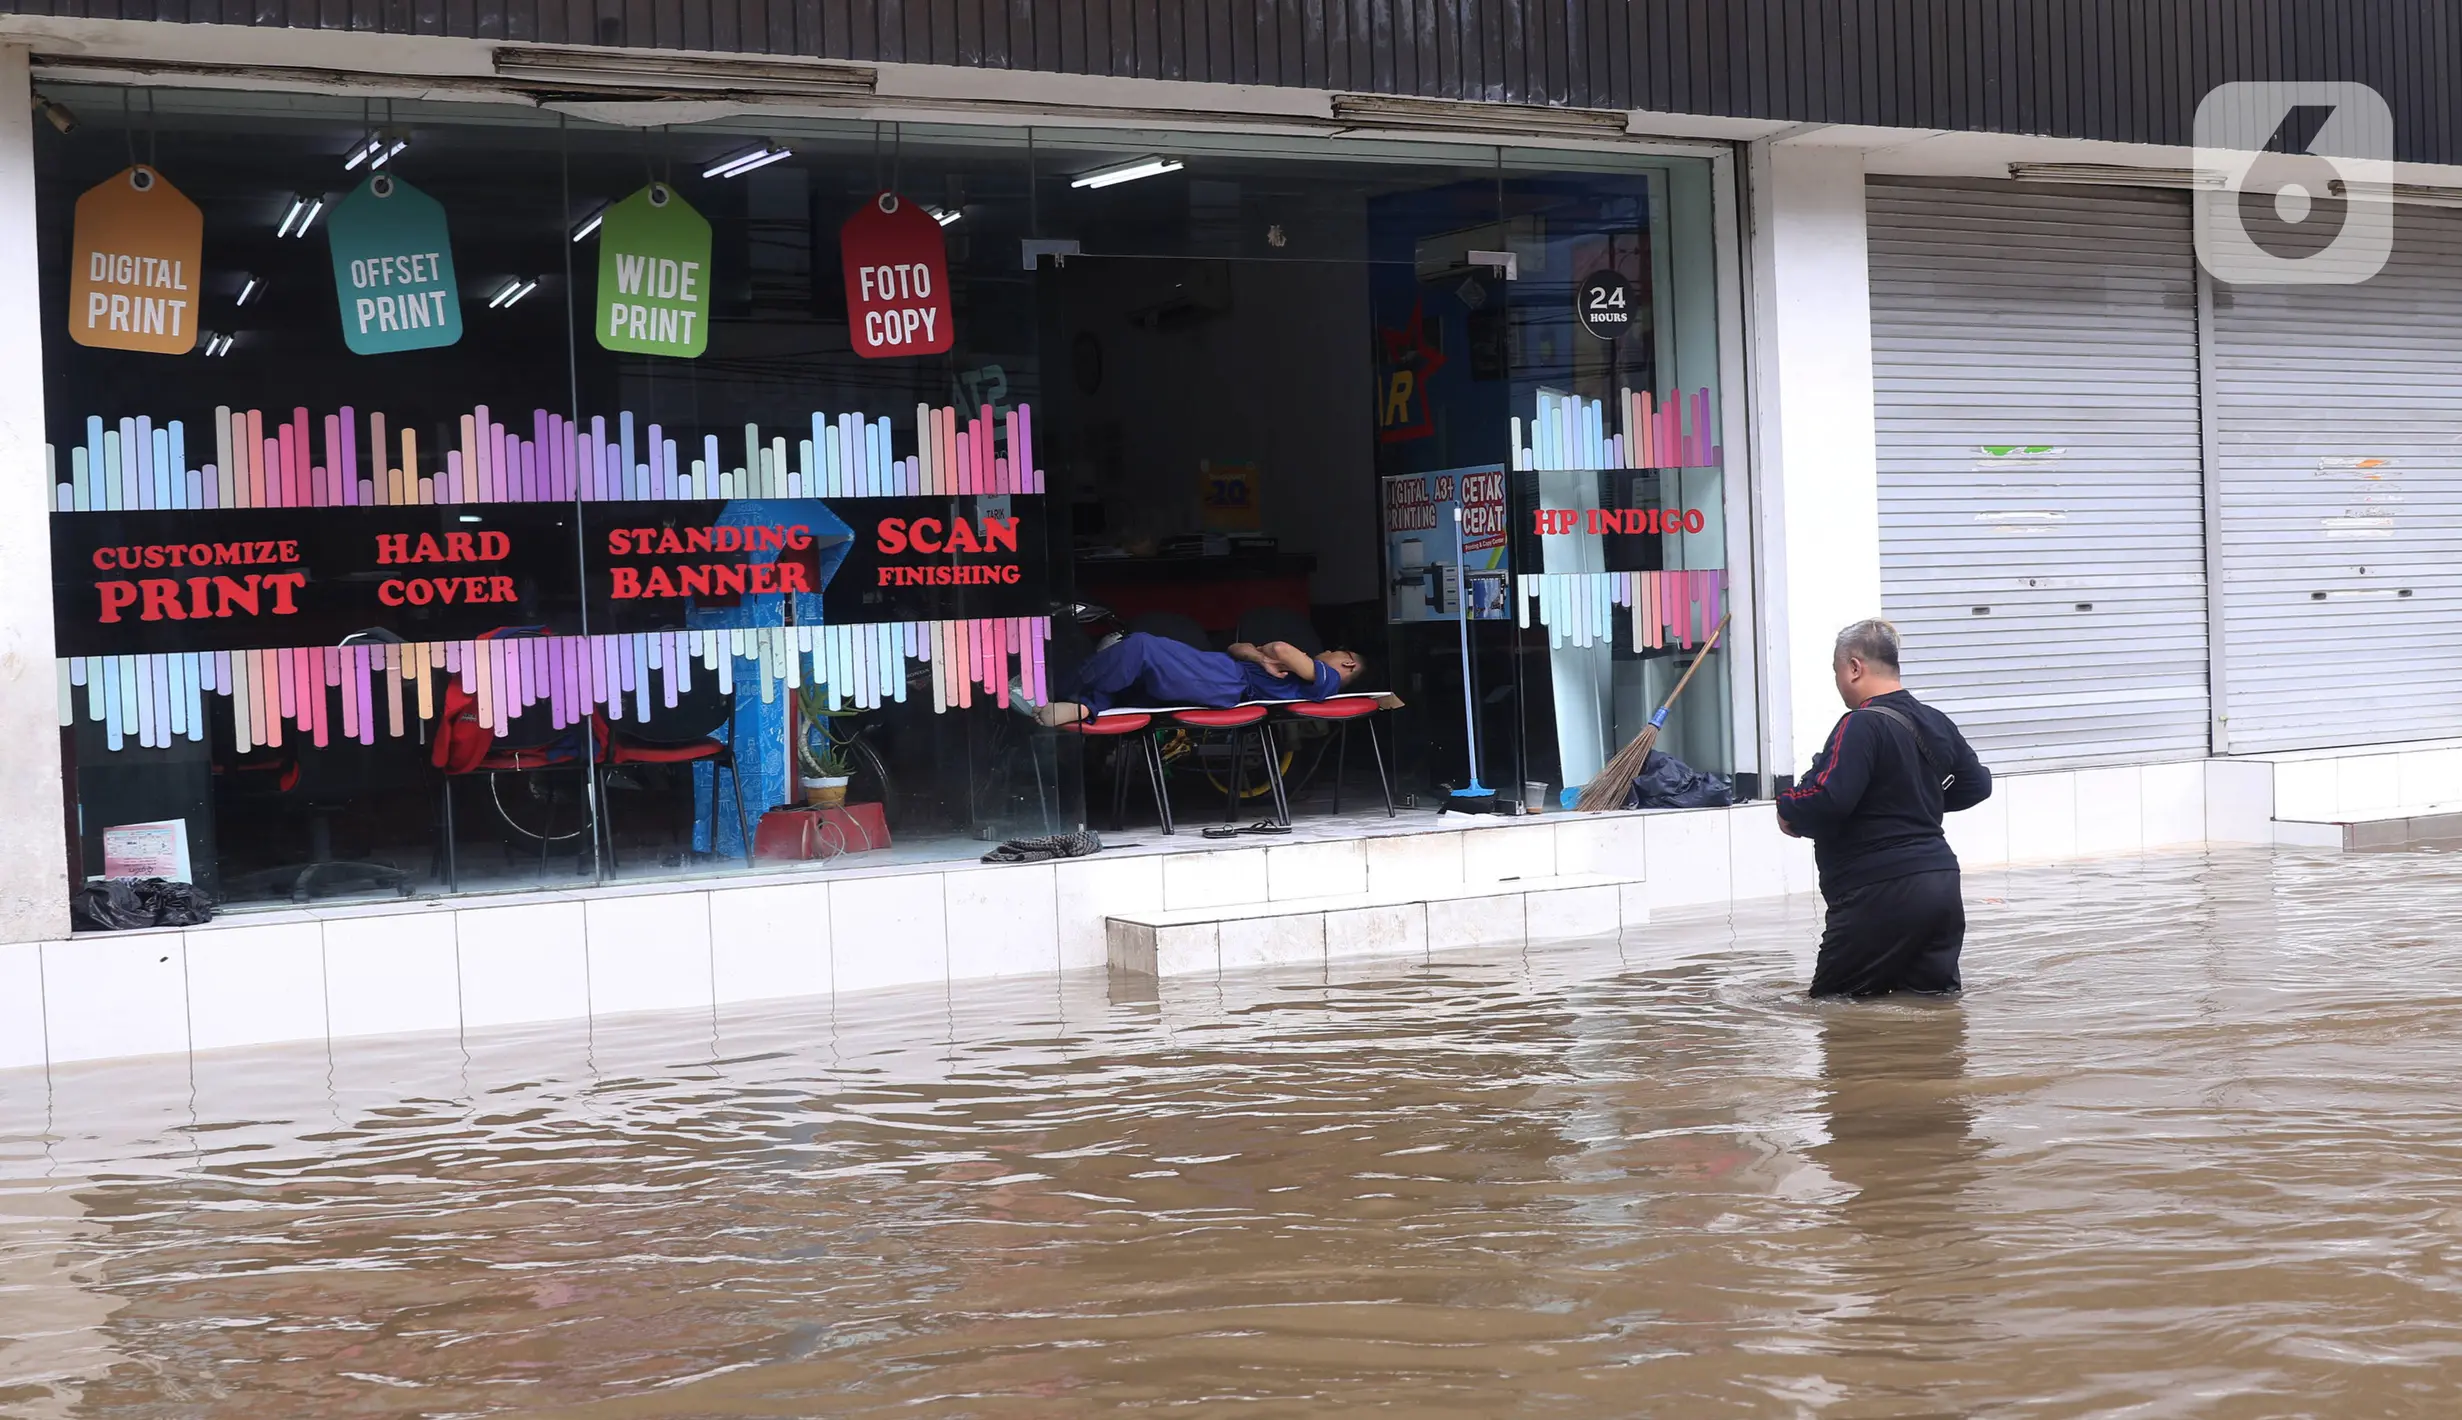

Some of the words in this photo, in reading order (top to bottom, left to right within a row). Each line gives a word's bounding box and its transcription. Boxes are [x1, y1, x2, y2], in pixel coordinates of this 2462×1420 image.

[90, 252, 187, 291] DIGITAL
[351, 253, 440, 289] OFFSET
[615, 253, 699, 302] WIDE
[859, 262, 931, 302] FOTO
[87, 291, 187, 337] PRINT
[355, 290, 447, 334] PRINT
[1590, 287, 1626, 309] 24
[610, 302, 697, 345] PRINT
[865, 307, 937, 347] COPY
[1590, 312, 1628, 323] HOURS
[1461, 473, 1504, 503] CETAK
[877, 517, 1020, 554] SCAN
[1462, 505, 1504, 536] CEPAT
[1533, 509, 1578, 535] HP
[1587, 509, 1704, 535] INDIGO
[93, 540, 300, 570] CUSTOMIZE
[376, 531, 510, 564] HARD
[608, 525, 812, 556] STANDING
[378, 575, 518, 606] COVER
[610, 562, 811, 599] BANNER
[877, 564, 1021, 587] FINISHING
[95, 573, 305, 623] PRINT
